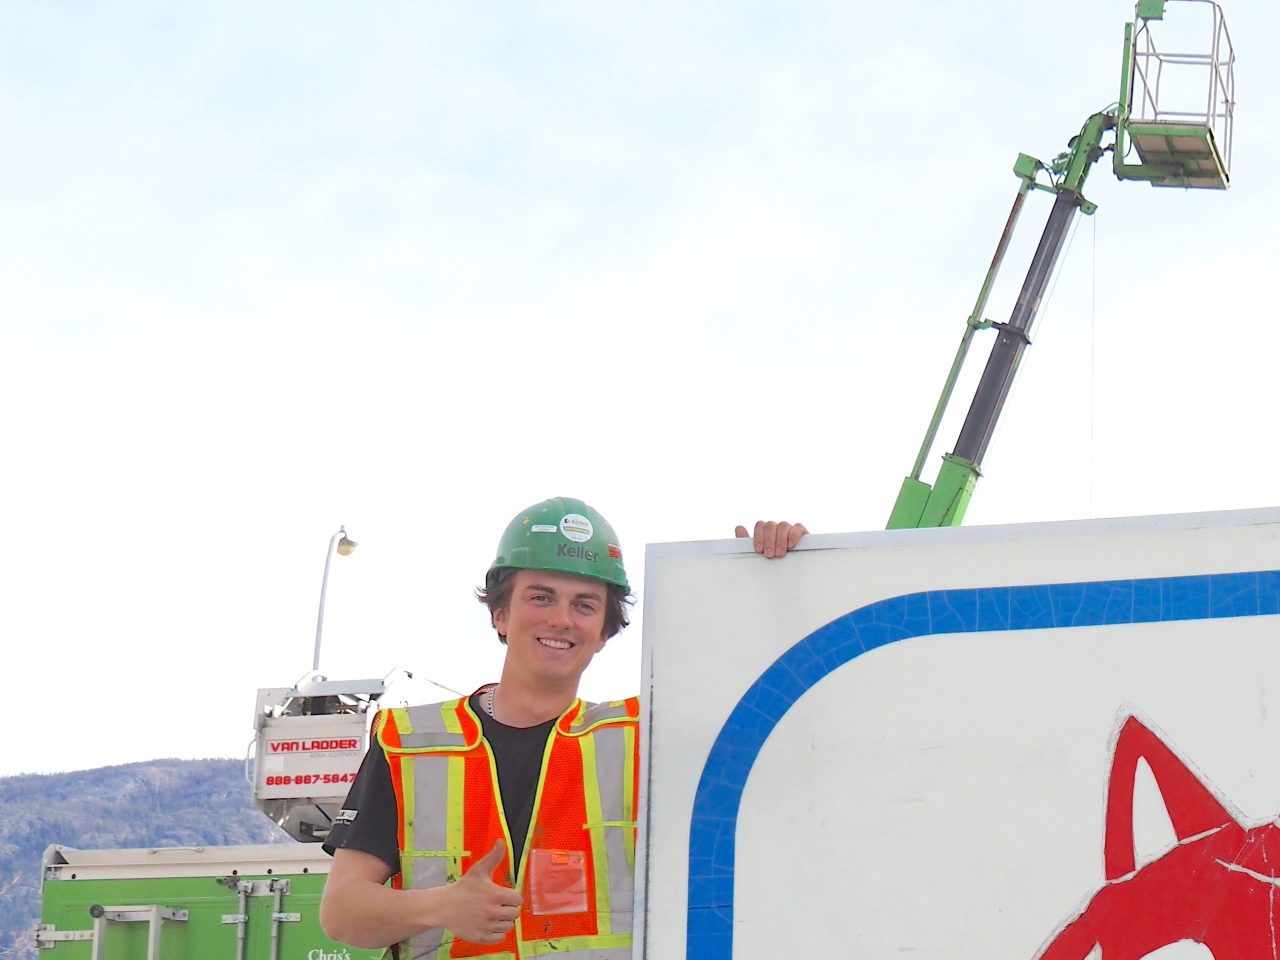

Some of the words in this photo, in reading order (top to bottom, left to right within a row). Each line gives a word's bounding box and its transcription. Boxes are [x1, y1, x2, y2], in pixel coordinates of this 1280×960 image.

[557, 543, 600, 562] Keller
[270, 741, 299, 753] VAN
[302, 739, 357, 751] LADDER
[266, 773, 357, 786] 888-887-5847
